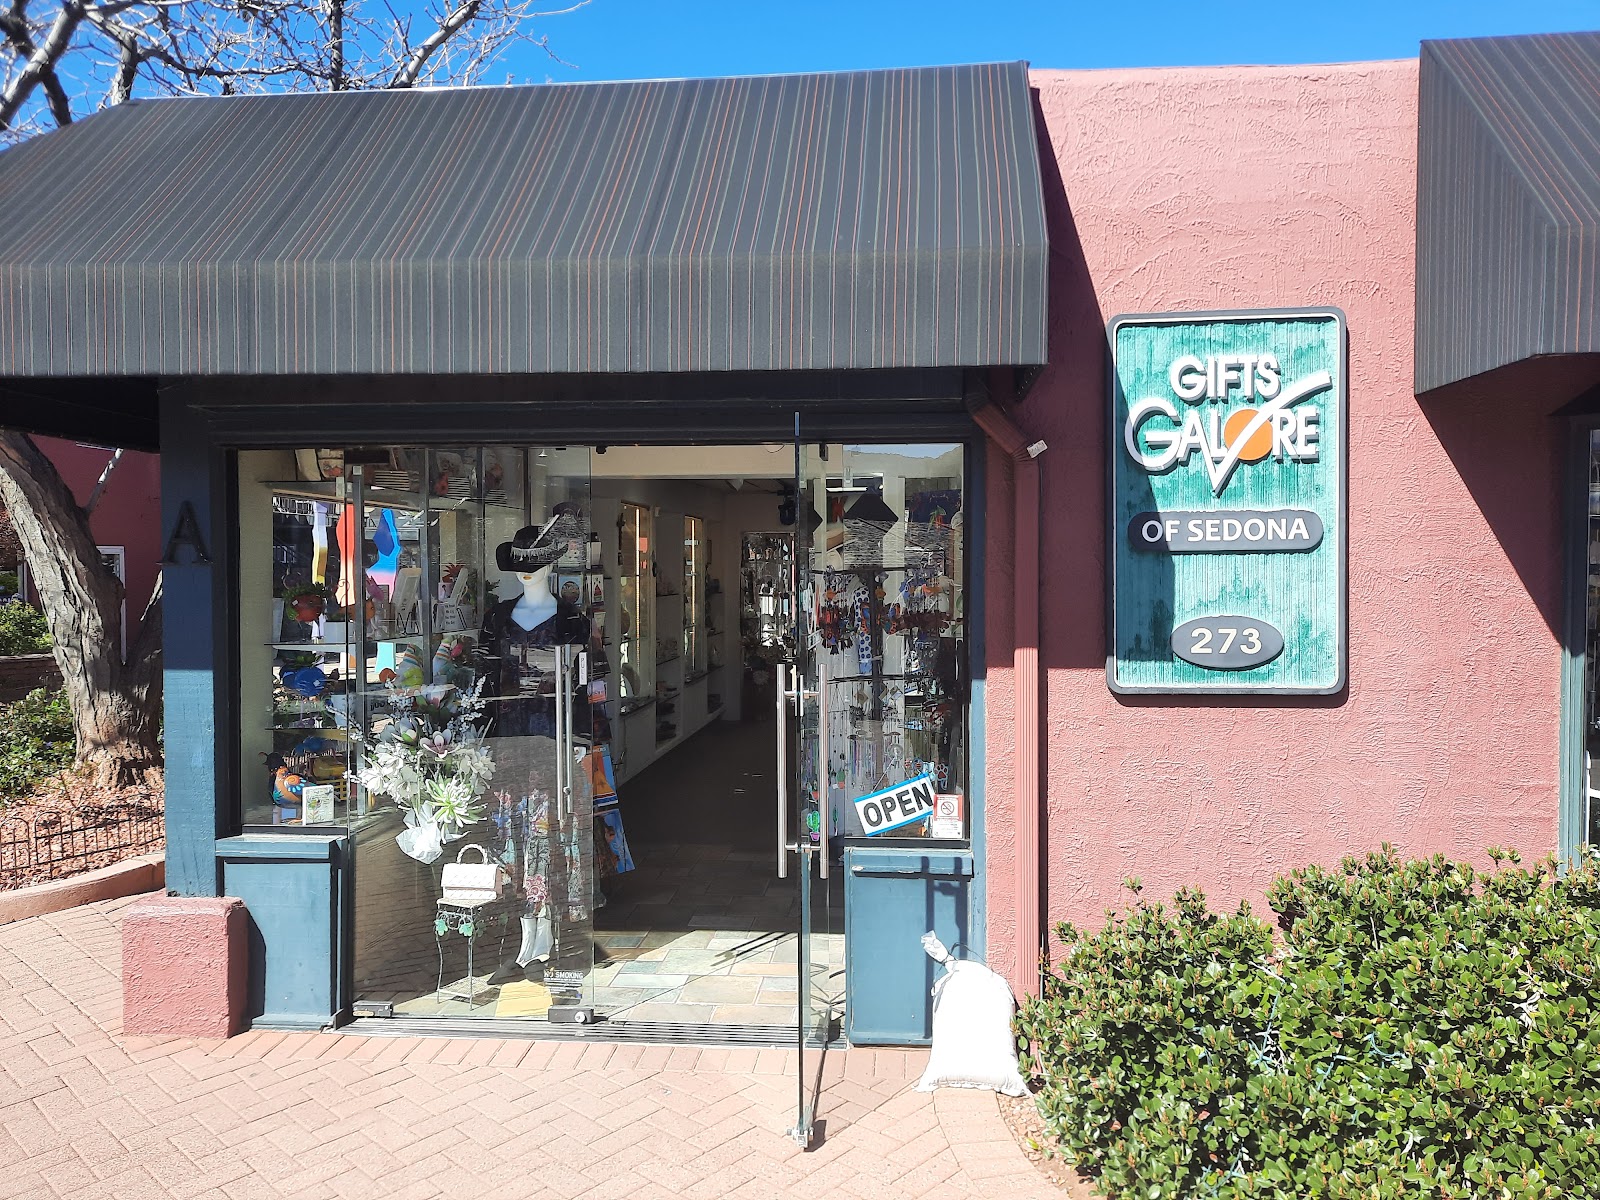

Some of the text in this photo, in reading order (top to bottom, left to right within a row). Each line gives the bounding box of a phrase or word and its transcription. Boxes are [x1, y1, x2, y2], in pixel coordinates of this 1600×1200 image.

[1171, 355, 1282, 402] GIFTS
[1124, 374, 1331, 496] GALORE
[158, 500, 212, 565] A
[1142, 518, 1309, 542] OF SEDONA
[1191, 628, 1262, 654] 273
[863, 782, 934, 828] OPEN
[555, 971, 584, 979] SMOKING
